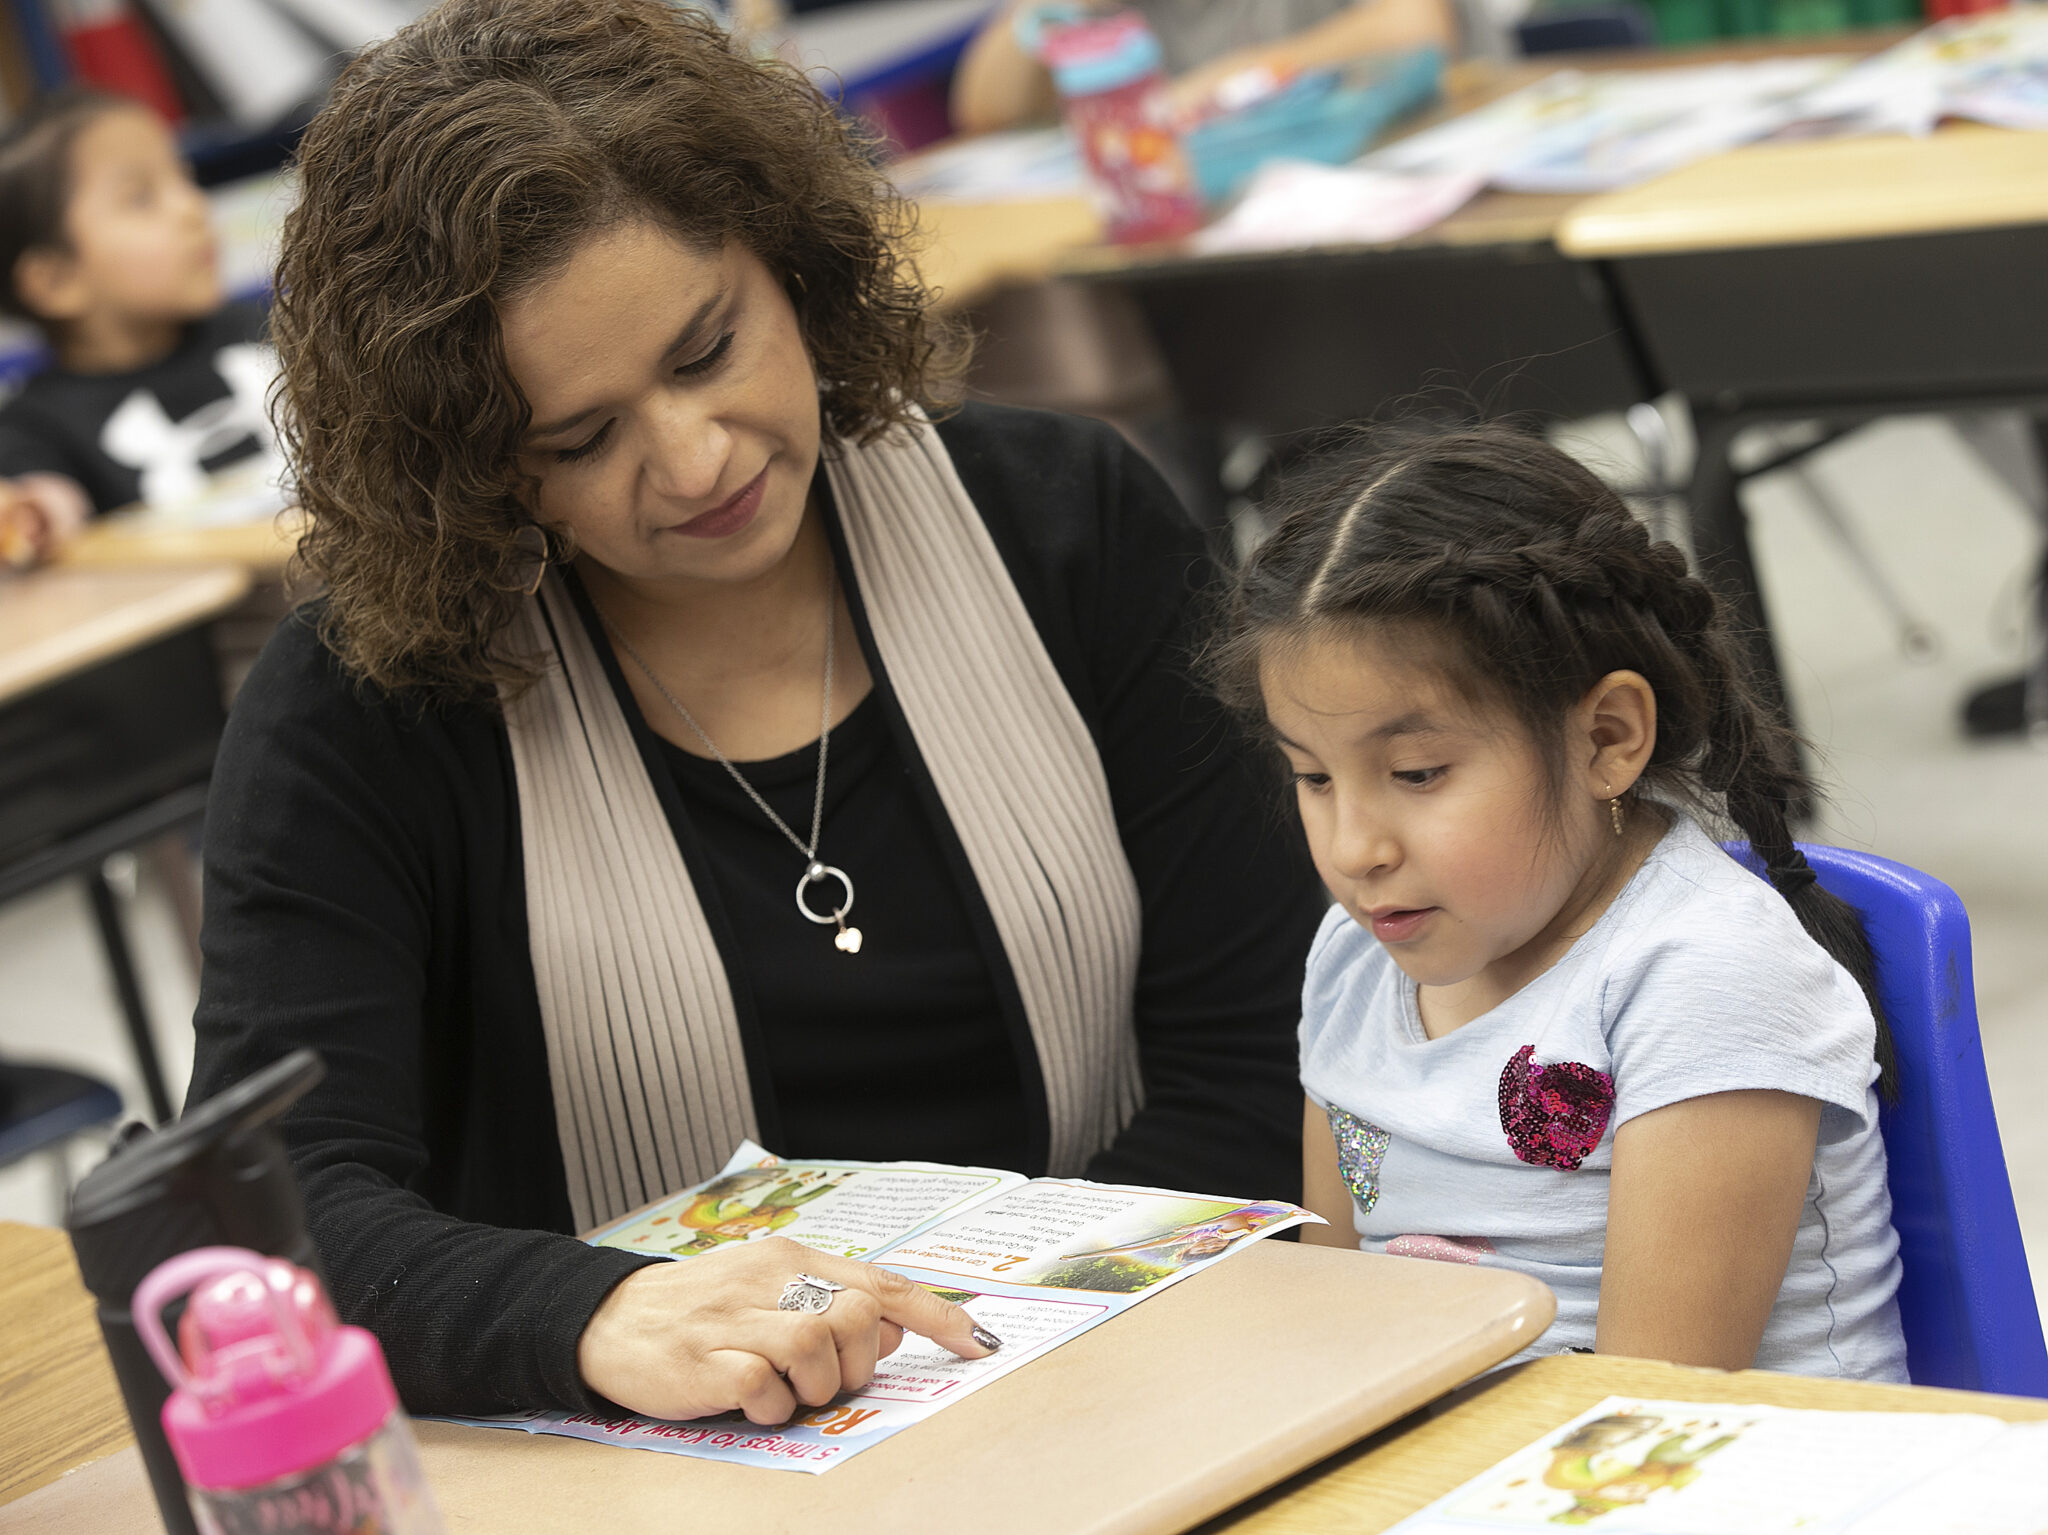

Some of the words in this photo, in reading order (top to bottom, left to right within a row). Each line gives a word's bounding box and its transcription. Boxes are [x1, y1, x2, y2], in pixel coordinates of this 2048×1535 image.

[933, 1231, 956, 1239] sunny
[1017, 1234, 1041, 1242] Make
[1045, 1229, 1075, 1239] behind
[975, 1238, 1005, 1246] outside
[929, 1244, 979, 1255] rainbow?
[918, 1251, 945, 1260] make
[945, 1255, 967, 1263] you
[902, 1376, 920, 1384] for
[561, 1412, 643, 1434] About
[644, 1424, 716, 1443] Know
[714, 1434, 743, 1446] to
[742, 1436, 817, 1458] Things
[815, 1447, 839, 1461] 5
